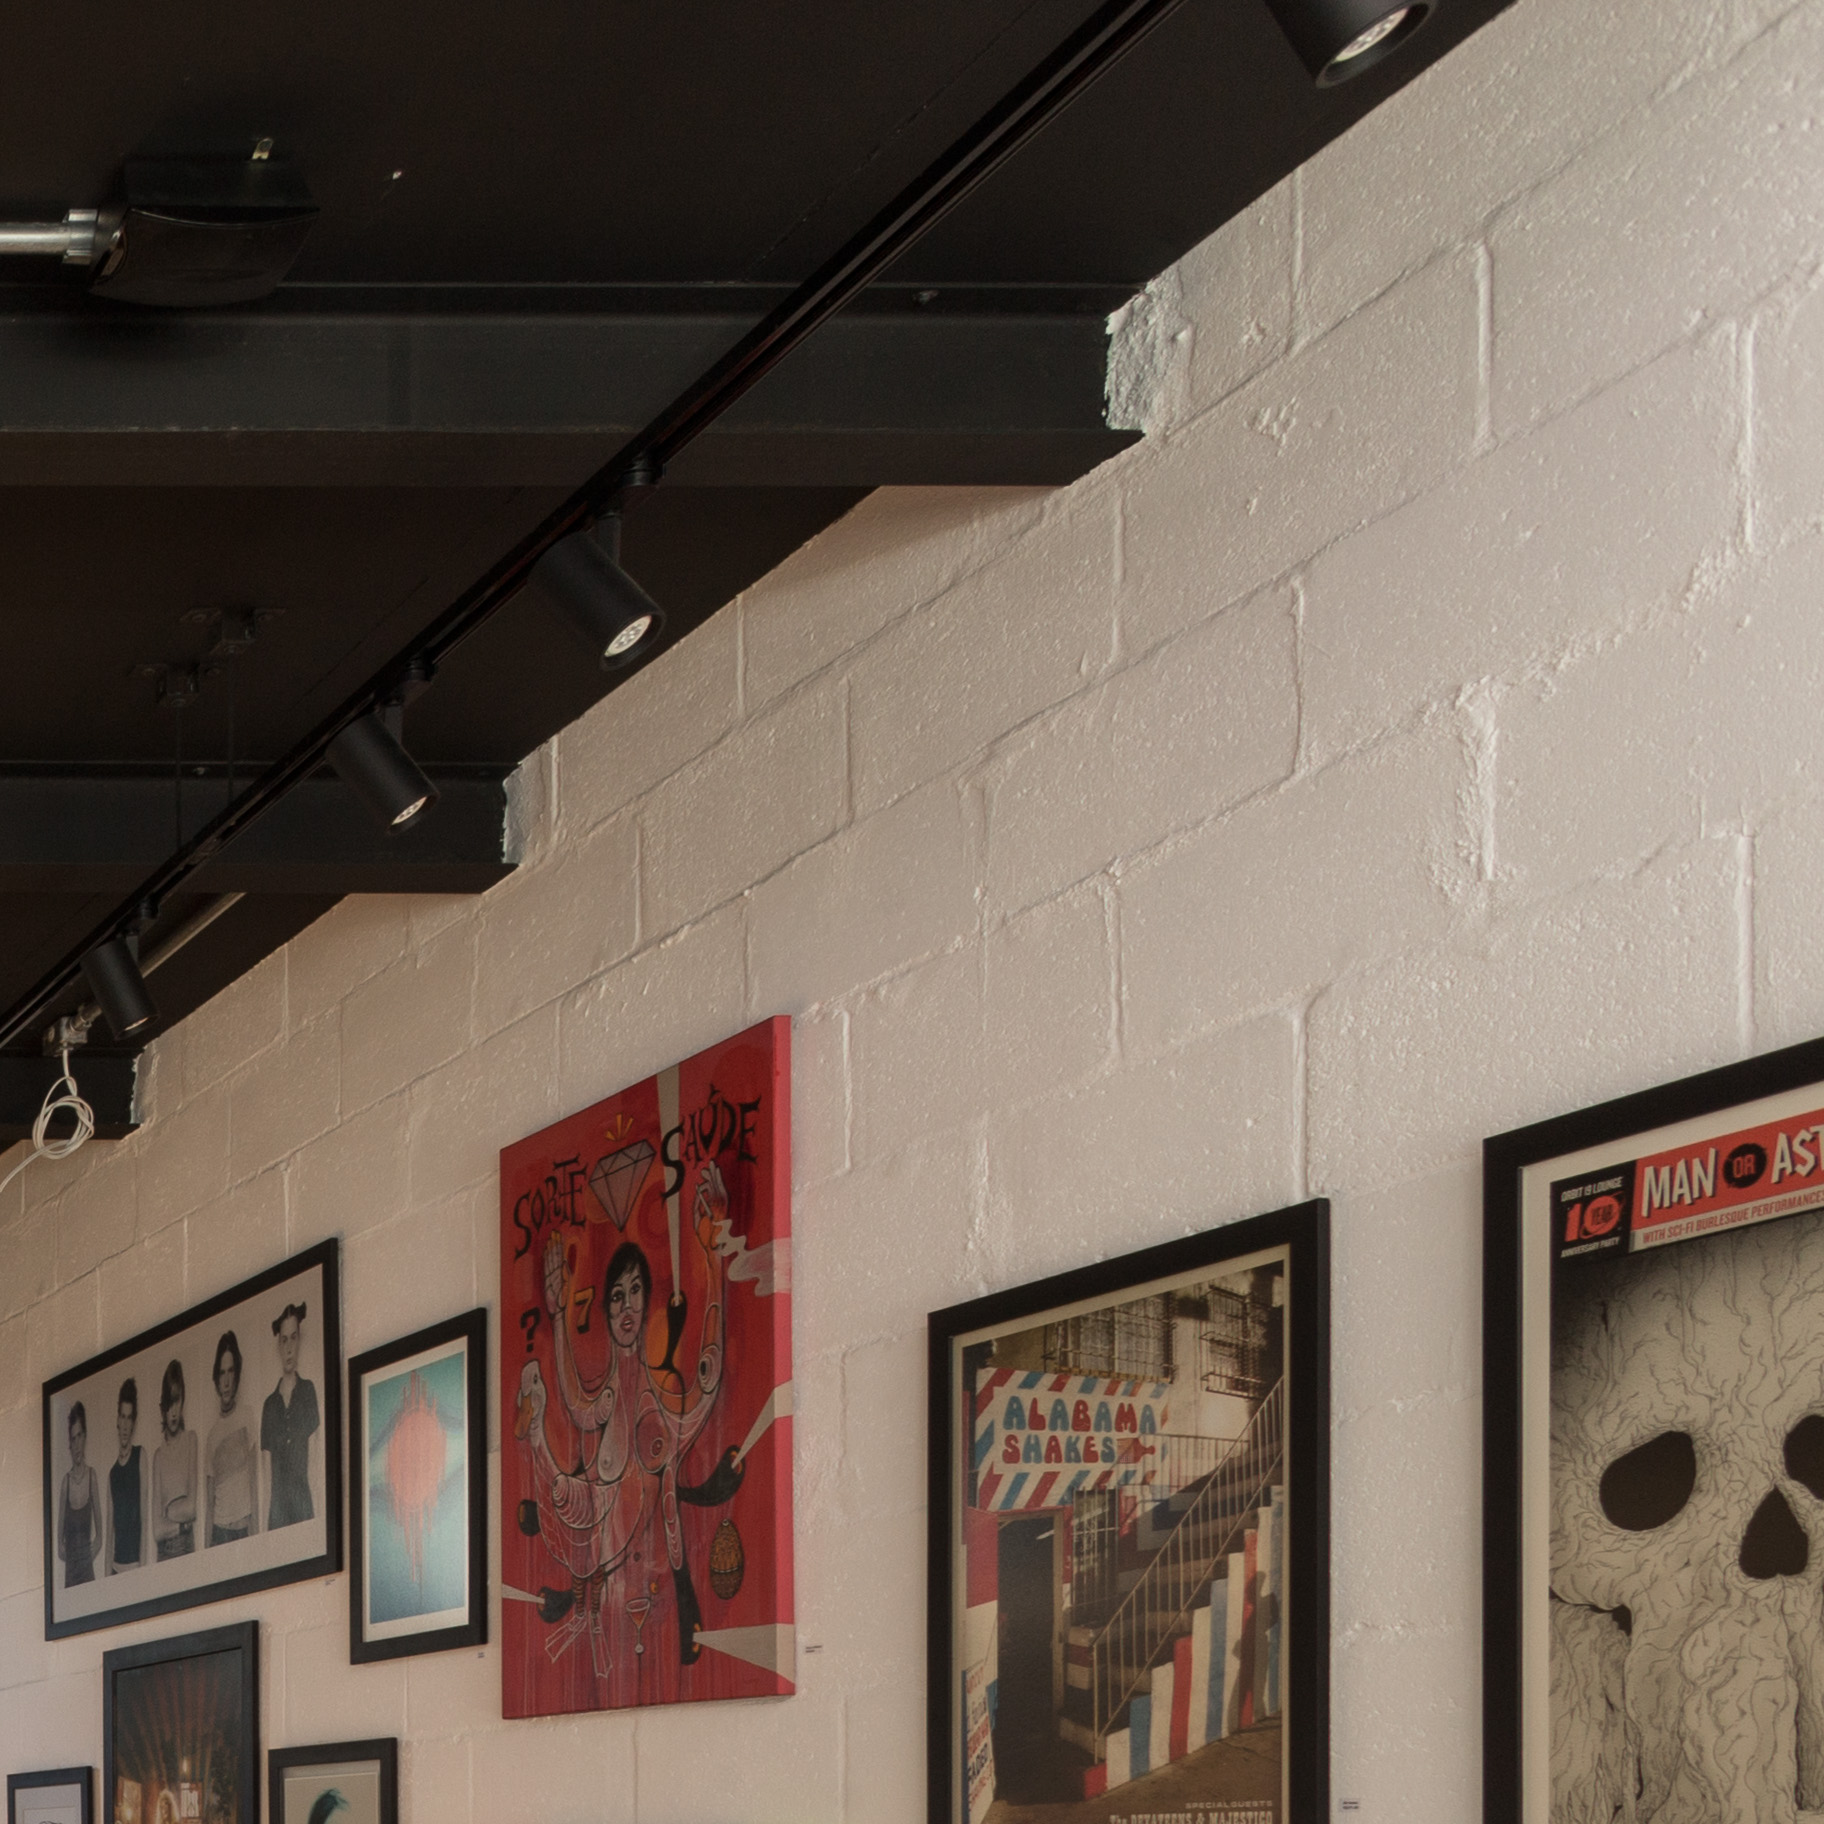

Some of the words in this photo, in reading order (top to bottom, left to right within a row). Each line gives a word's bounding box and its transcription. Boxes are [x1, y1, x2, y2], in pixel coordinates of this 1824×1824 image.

[660, 1082, 762, 1207] SAÚDE
[1641, 1147, 1717, 1218] MAN
[1733, 1154, 1755, 1179] OR
[513, 1153, 588, 1263] SORTE
[1643, 1229, 1665, 1244] WITH
[1667, 1222, 1694, 1239] SCI-FI
[1696, 1208, 1749, 1231] BURLESQUE
[575, 1285, 595, 1334] 7
[1003, 1396, 1156, 1434] ALABAMA
[1003, 1434, 1115, 1464] SHAKES
[1185, 1802, 1228, 1810] SPECIAL
